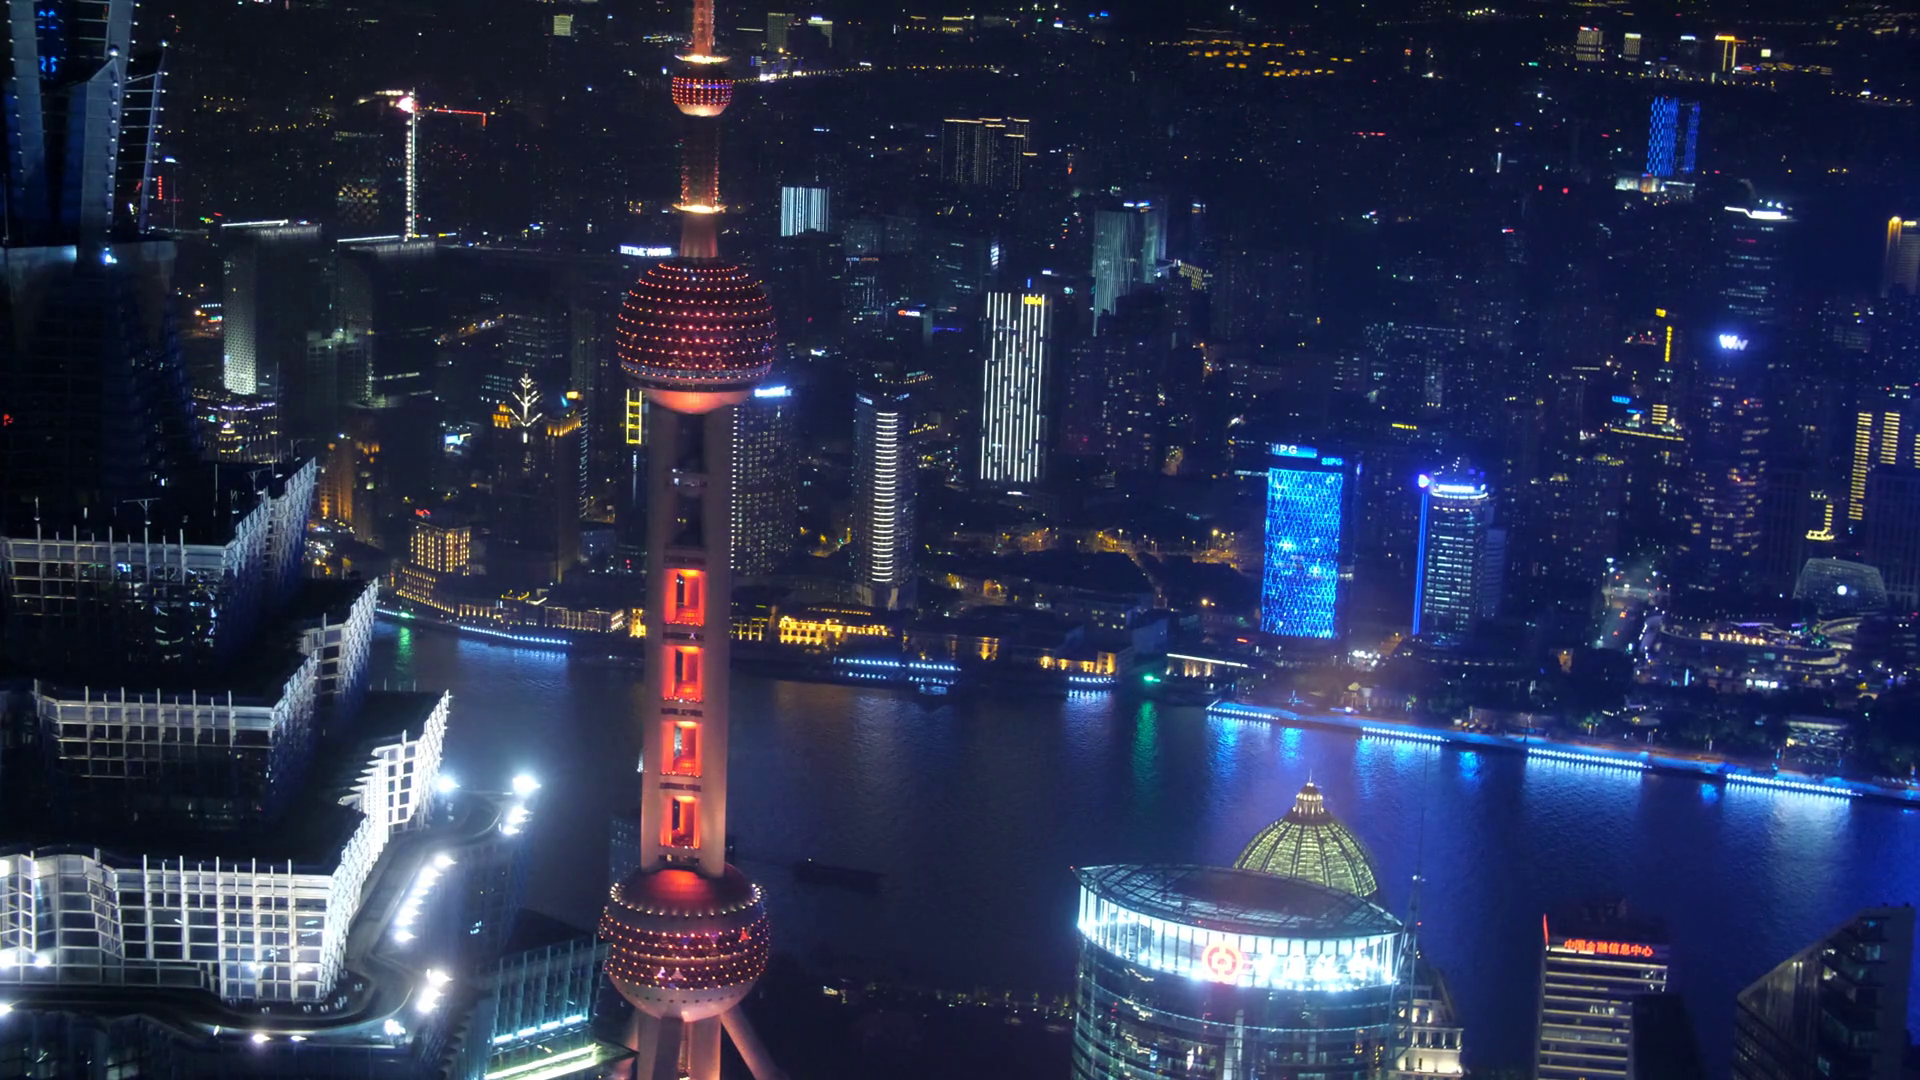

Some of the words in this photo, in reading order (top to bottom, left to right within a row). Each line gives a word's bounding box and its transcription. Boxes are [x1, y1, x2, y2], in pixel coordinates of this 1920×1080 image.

[1321, 457, 1343, 466] SIPG
[1564, 938, 1654, 957] 中国金融信息中心
